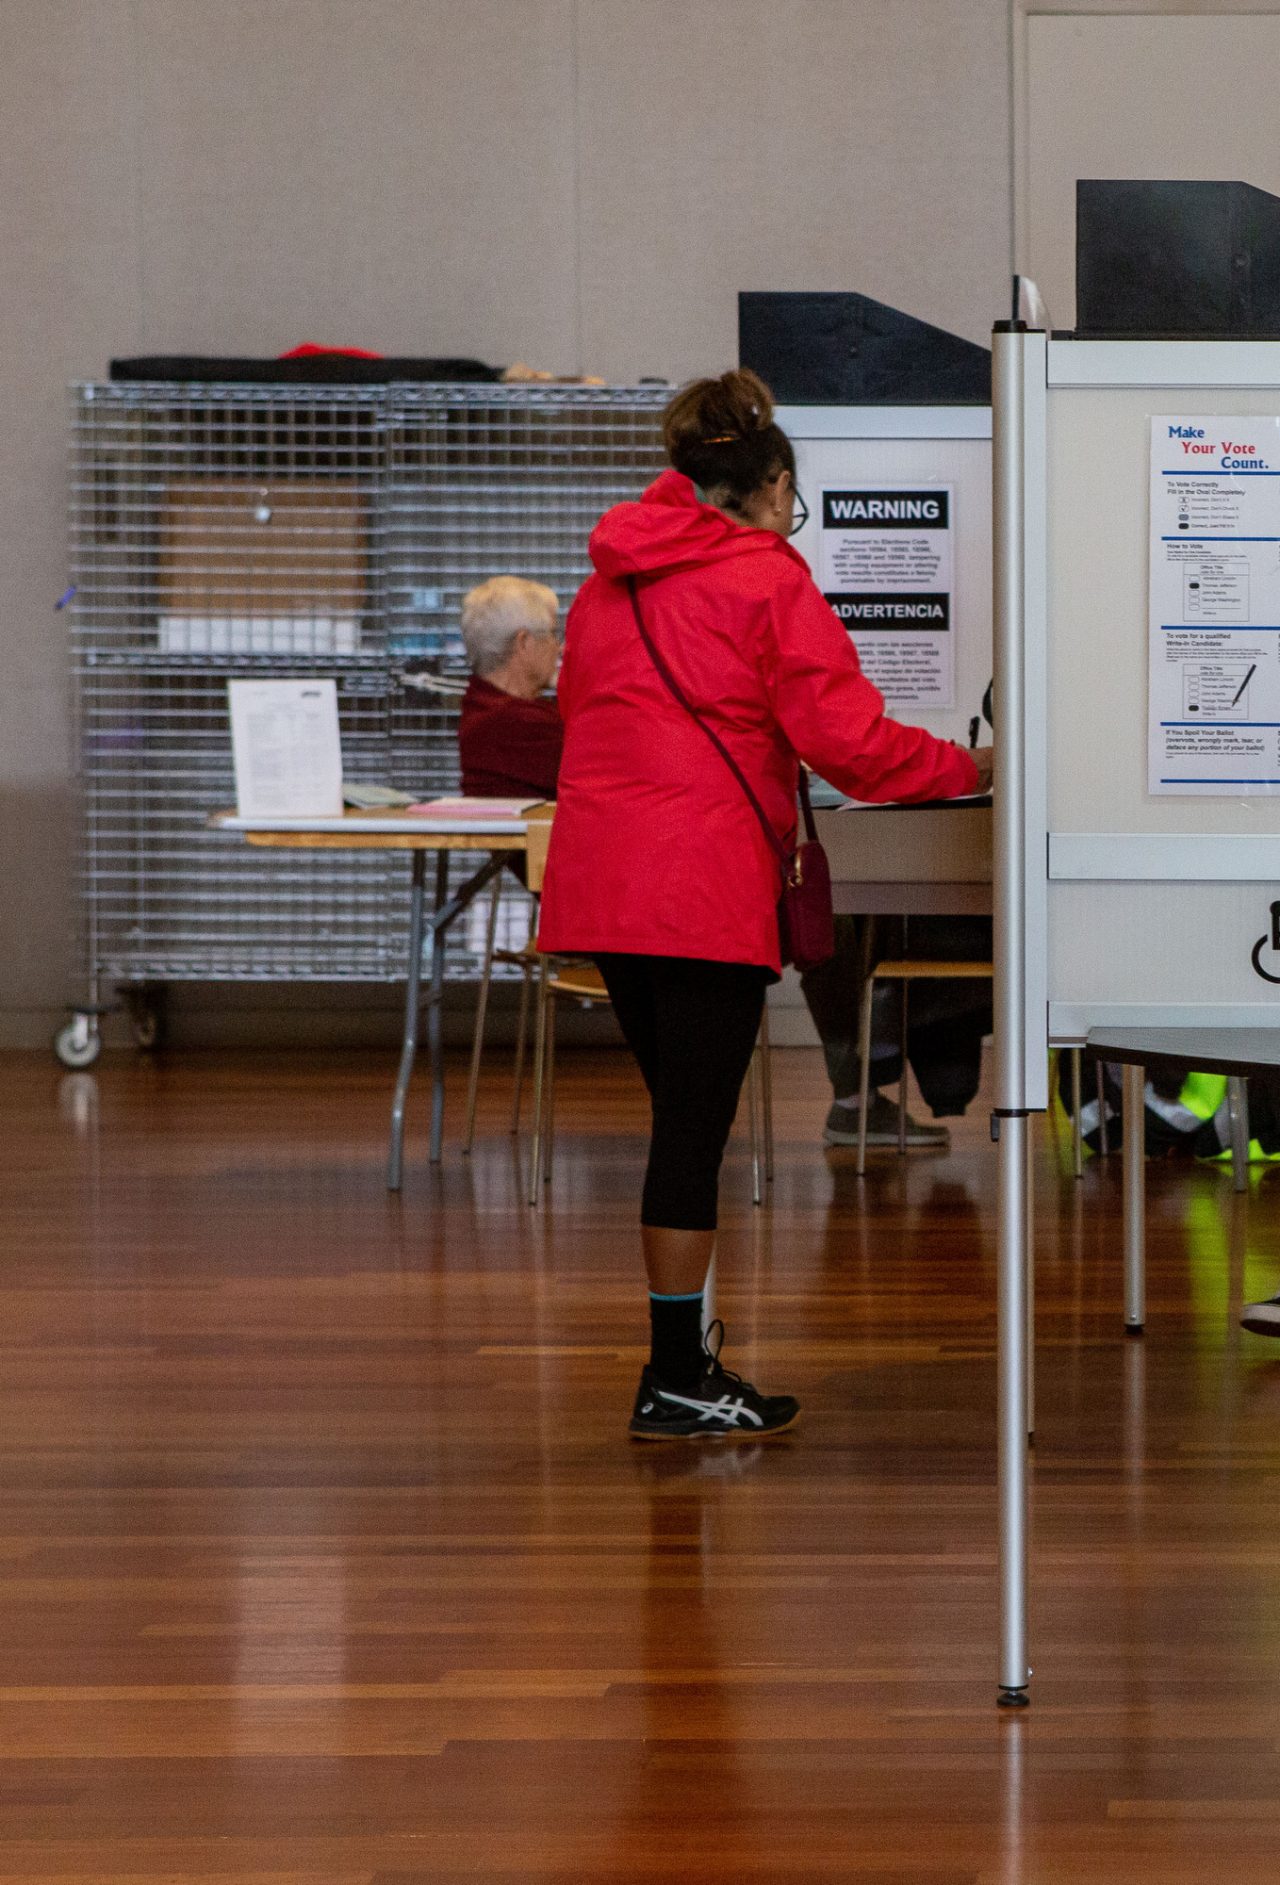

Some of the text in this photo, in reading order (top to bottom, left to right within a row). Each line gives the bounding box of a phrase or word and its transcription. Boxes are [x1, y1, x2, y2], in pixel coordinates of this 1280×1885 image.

[1168, 426, 1205, 438] Make
[1181, 441, 1256, 454] Your Vote
[1221, 456, 1269, 469] Count.
[830, 500, 939, 519] WARNING
[832, 604, 944, 618] ADVERTENCIA
